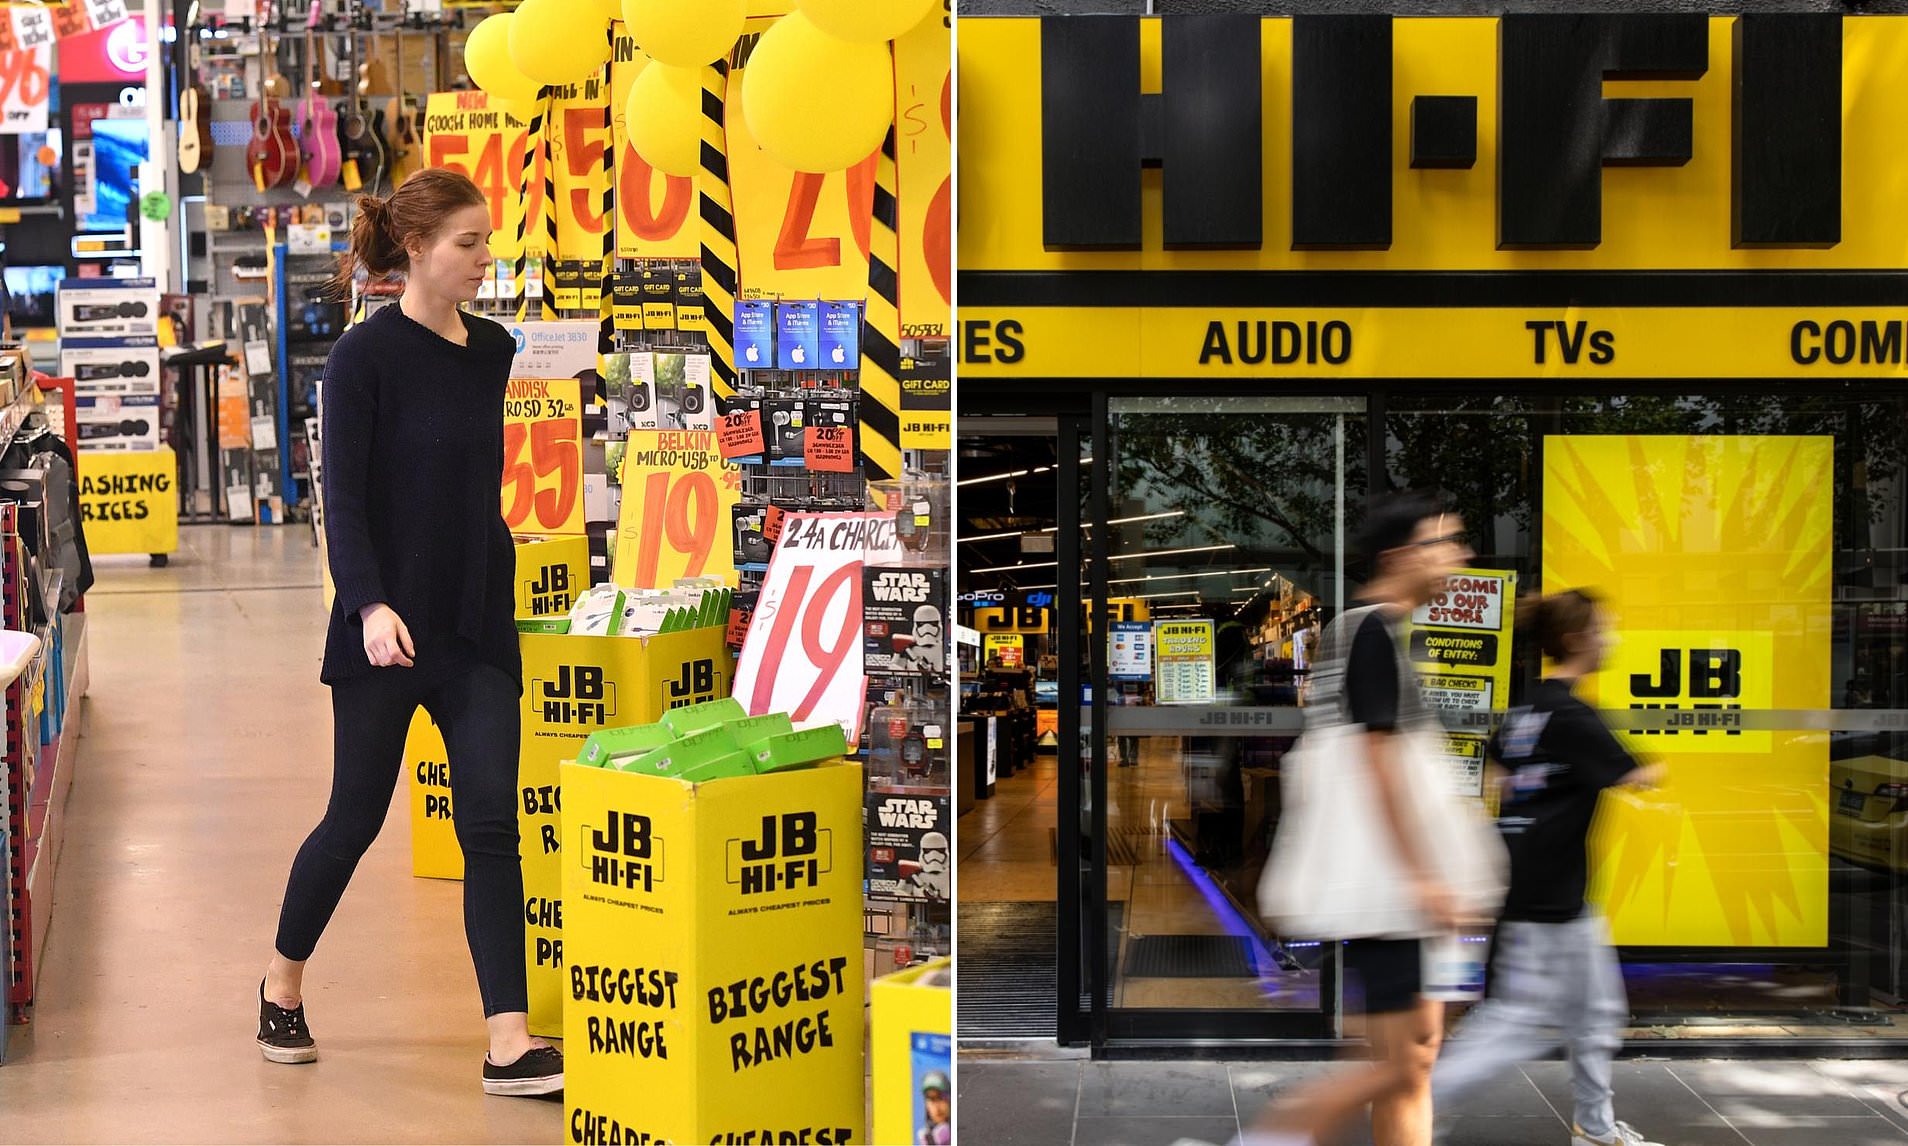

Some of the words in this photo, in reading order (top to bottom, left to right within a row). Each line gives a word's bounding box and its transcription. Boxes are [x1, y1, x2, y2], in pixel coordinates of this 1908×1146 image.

[469, 112, 498, 129] HOME
[1199, 320, 1352, 364] AUDIO
[1525, 321, 1615, 365] TVs
[1790, 320, 1908, 364] COM
[902, 380, 922, 389] GIFT
[923, 380, 949, 389] CARD
[903, 423, 920, 432] JB
[658, 432, 711, 451] BELKIN
[637, 451, 708, 470] MICRO-USB
[79, 473, 170, 497] ASHING
[532, 563, 569, 594] JB
[872, 573, 930, 588] STAR
[1440, 577, 1498, 594] COME
[872, 587, 930, 602] WARS
[1026, 591, 1053, 607] dji
[1453, 593, 1489, 609] OUR
[987, 605, 1042, 628] JB
[1428, 607, 1484, 624] STORE
[1163, 626, 1179, 634] JB
[749, 559, 865, 722] 19
[1425, 636, 1484, 649] CONDITIONS
[1428, 649, 1441, 658] OF
[1443, 649, 1478, 660] ENTRY:
[544, 665, 604, 700] JB
[671, 658, 713, 697] JB
[1630, 648, 1741, 698] JB
[1448, 679, 1477, 688] CHECKS
[1200, 712, 1226, 724] JB
[1462, 713, 1489, 725] JB
[1667, 714, 1694, 727] JB
[416, 761, 451, 788] CHE
[878, 798, 937, 814] STAR
[878, 813, 937, 829] WARS
[592, 810, 652, 859] JB
[741, 811, 818, 861] JB
[583, 893, 606, 903] ALWAYS
[607, 898, 639, 909] CHEAPEST
[640, 905, 664, 914] PRICES
[728, 907, 759, 916] ALWAYS
[760, 901, 801, 913] CHEAPEST
[802, 898, 831, 907] PRICES
[570, 964, 679, 1009] BIGGEST
[708, 956, 847, 1025] BIGGEST
[587, 1016, 668, 1060] RANGE
[730, 1009, 833, 1073] RANGE
